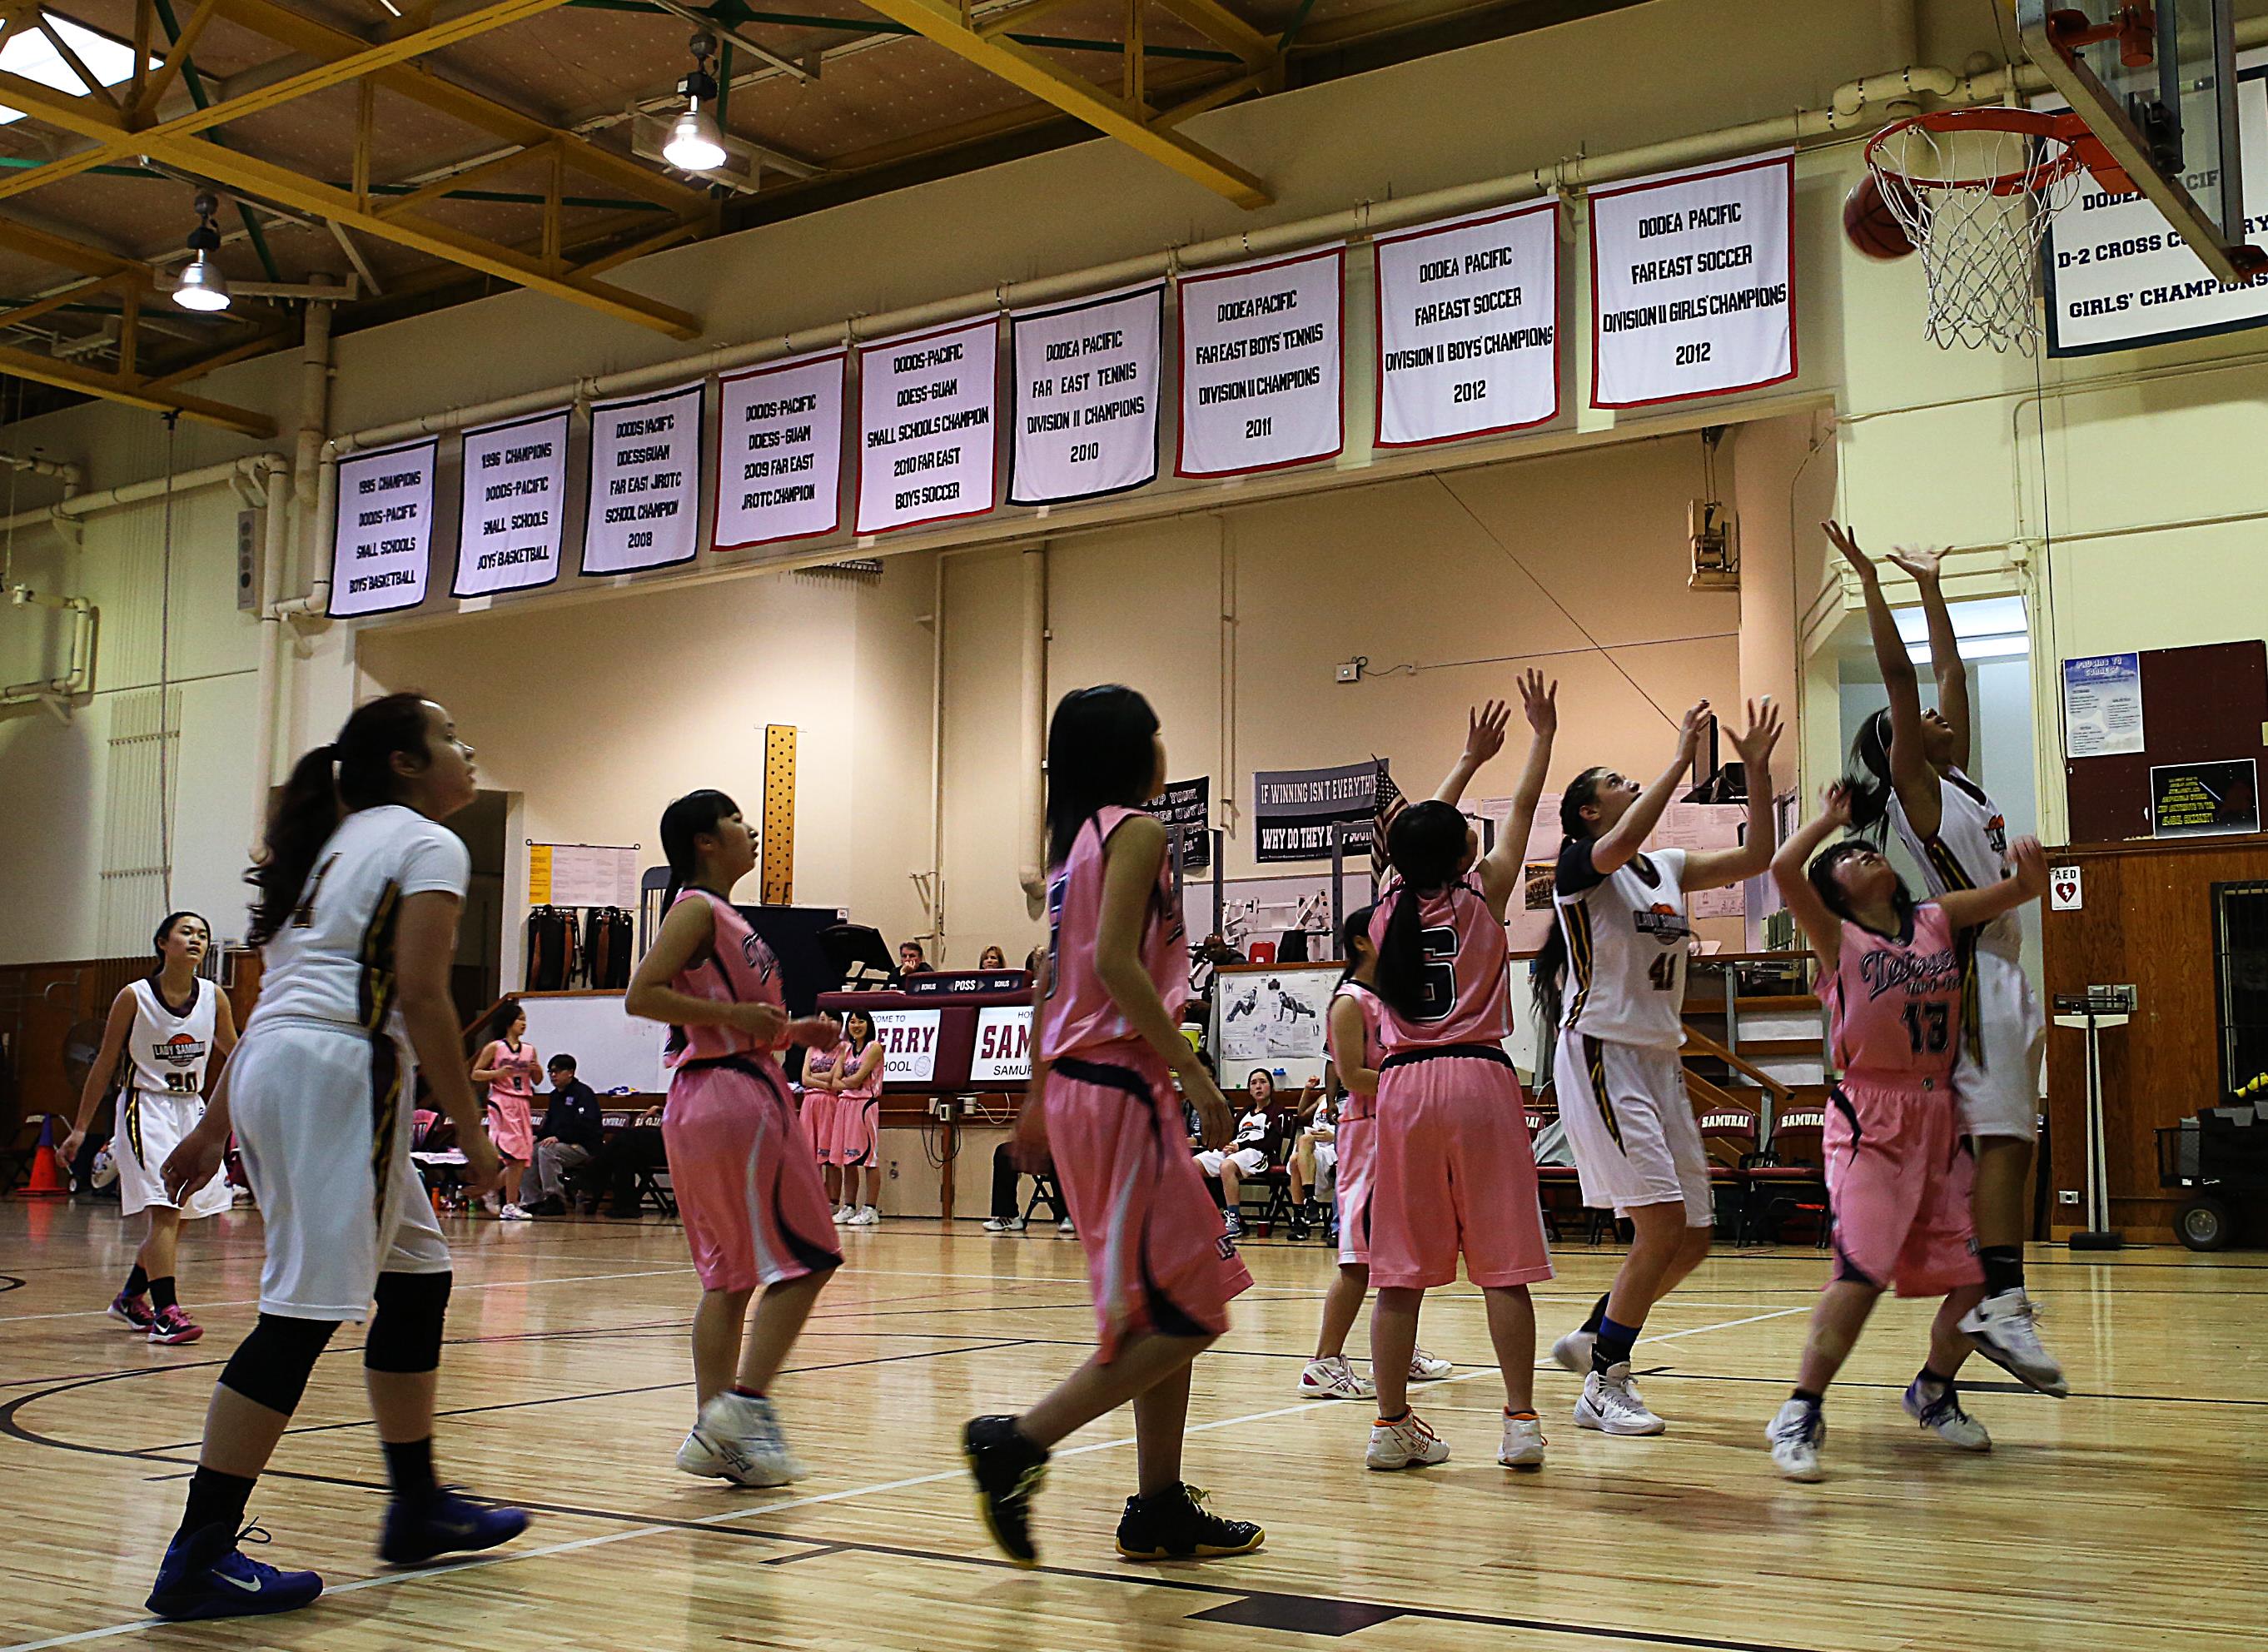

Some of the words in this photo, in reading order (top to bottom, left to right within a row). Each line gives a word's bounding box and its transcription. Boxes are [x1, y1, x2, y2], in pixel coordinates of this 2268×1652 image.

[1639, 212, 1683, 239] DODEA
[1689, 202, 1742, 230] PACIFIC
[2057, 248, 2091, 268] D-2
[2096, 234, 2161, 261] CROSS
[1419, 258, 1460, 284] DODEA
[1465, 247, 1512, 274] PACIFIC
[1631, 261, 1657, 285] FAR
[1659, 255, 1694, 280] EAST
[1697, 244, 1753, 273] SOCCER
[1217, 298, 1255, 323] DODEA
[1256, 290, 1297, 315] PACIFIC
[1415, 305, 1437, 326] FAR
[1437, 297, 1470, 322] EAST
[1474, 286, 1522, 316] SOCCER
[1603, 305, 1657, 333] DIVISION
[1659, 304, 1667, 324] II
[1709, 283, 1786, 315] CHAMPIONS
[2069, 292, 2134, 318] GIRLS'
[1046, 341, 1080, 362] DODEA
[1082, 331, 1123, 356] PACIFIC
[1196, 344, 1219, 366] FAR
[1219, 339, 1247, 361] EAST
[1282, 323, 1324, 351] TENNIS
[1385, 346, 1434, 372] DIVISION
[1436, 343, 1445, 363] II
[1484, 326, 1554, 356] CHAMPIONS
[1676, 341, 1711, 366] 2012
[1032, 379, 1052, 399] FAR
[1061, 373, 1090, 394] EAST
[1097, 362, 1136, 387] TENNIS
[1199, 379, 1247, 406] DIVISION
[1256, 366, 1320, 396] CHAMPIONS
[1453, 380, 1486, 404] 2012
[868, 427, 897, 448] SMALL
[898, 416, 941, 440] SCHOOLS
[942, 406, 989, 432] CHAMPION
[1027, 411, 1070, 435] DIVISION
[1084, 396, 1145, 425] CHAMPIONS
[1246, 416, 1272, 439] 2011
[505, 442, 552, 464] CHAMPIONS
[893, 455, 917, 477] 2010
[917, 451, 935, 471] FAR
[936, 447, 961, 467] EAST
[1070, 441, 1099, 463] 2010
[744, 461, 769, 480] 2009
[769, 457, 789, 476] FAR
[790, 453, 814, 473] EAST
[379, 470, 421, 491] CHAMPIONS
[609, 479, 626, 495] FAR
[628, 475, 649, 492] EAST
[651, 471, 682, 490] JROTC
[741, 490, 773, 510] JROTC
[773, 484, 815, 507] CHAMPION
[895, 489, 921, 510] BOYS
[921, 482, 960, 505] SOCCER
[483, 518, 506, 535] SMALL
[511, 510, 549, 530] SCHOOLS
[604, 505, 637, 524] SCHOOL
[638, 500, 679, 520] CHAMPION
[356, 542, 378, 559] SMALL
[380, 537, 416, 555] SCHOOLS
[628, 531, 653, 549] 2008
[499, 545, 550, 566] BASKETBALL
[368, 570, 416, 590] BASKETBALL
[1261, 784, 1269, 804] IF
[1271, 783, 1308, 804] WINNING
[1175, 802, 1207, 820] UNTIL
[1262, 828, 1286, 849] WHY
[1287, 828, 1299, 848] DO
[1300, 826, 1325, 848] THEY
[2055, 869, 2076, 880] AED
[1649, 952, 1677, 990] 41
[954, 979, 976, 991] POSS
[873, 1015, 893, 1023] COME
[895, 1014, 906, 1023] TO
[878, 1026, 936, 1053] ERRY
[884, 1061, 912, 1072] HOOL
[1701, 1115, 1749, 1128] SAMURAI
[1782, 1113, 1824, 1127] SAMURA
